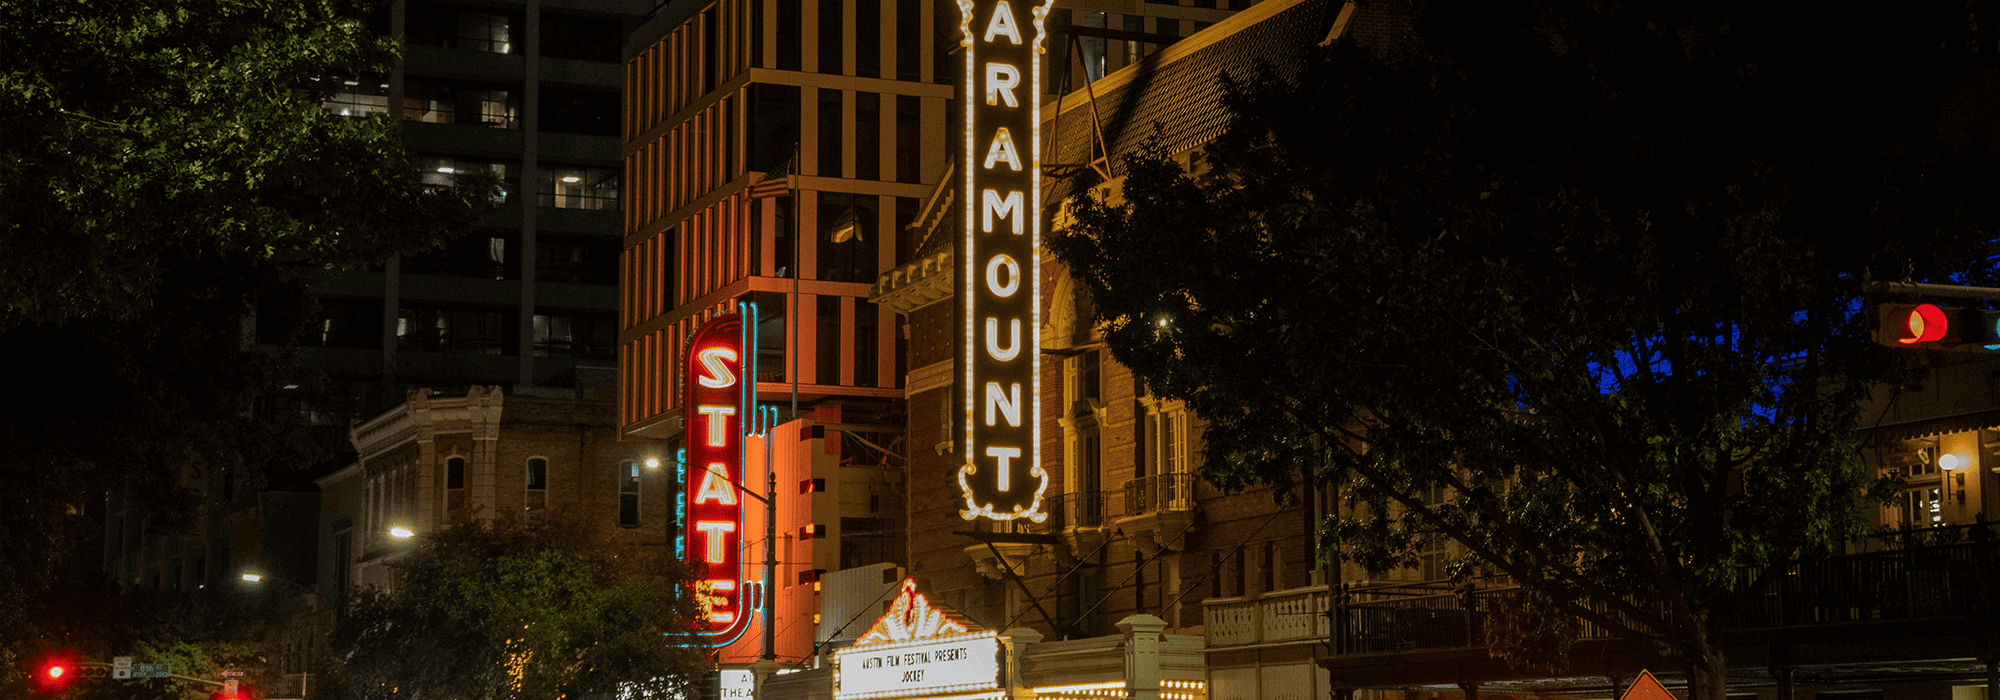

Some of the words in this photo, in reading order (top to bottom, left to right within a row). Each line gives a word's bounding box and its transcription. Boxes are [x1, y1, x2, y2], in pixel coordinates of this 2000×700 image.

[695, 348, 738, 623] STATE
[862, 656, 883, 669] AUSTIN
[886, 655, 900, 667] FILM
[903, 651, 931, 666] FESTIVAL
[934, 647, 967, 661] PRESENTS
[902, 669, 924, 683] JOCKEY
